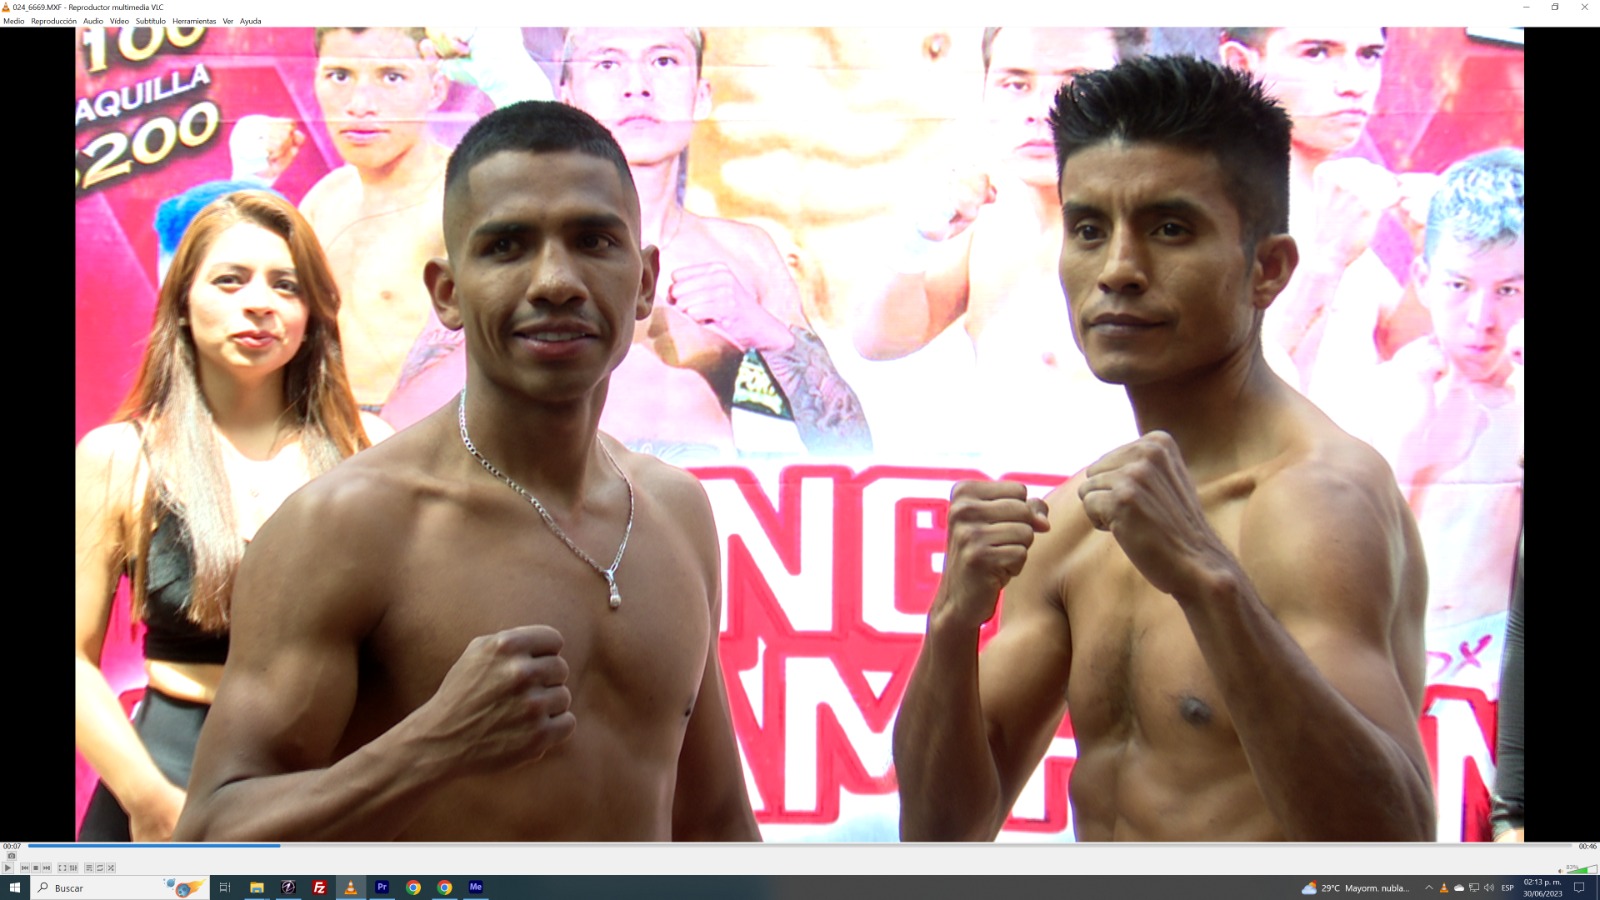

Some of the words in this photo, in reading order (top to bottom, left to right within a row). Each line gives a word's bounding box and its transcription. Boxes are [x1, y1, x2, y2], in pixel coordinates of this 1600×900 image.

[12, 3, 62, 12] 024_6669.MXF
[68, 3, 110, 12] Reproductor
[111, 3, 150, 11] multimedia
[3, 17, 25, 25] Medio
[31, 17, 77, 26] Reproducción
[83, 17, 104, 25] Audio
[110, 17, 130, 25] Vídeo
[135, 17, 166, 25] Subtítulo
[172, 17, 217, 25] Herramientas
[222, 17, 234, 25] Ver
[240, 17, 262, 26] Ayuda
[75, 101, 219, 189] 200
[1578, 842, 1598, 850] 00:46
[377, 882, 388, 891] Pr
[1523, 878, 1543, 886] 02:13
[55, 883, 84, 893] Buscar
[469, 882, 483, 892] Me
[1321, 884, 1341, 893] 29°C
[1345, 884, 1380, 895] Mayorm.
[1381, 884, 1410, 893] nubla...
[1501, 884, 1515, 892] ESP
[1522, 890, 1563, 898] 30/06/2023
